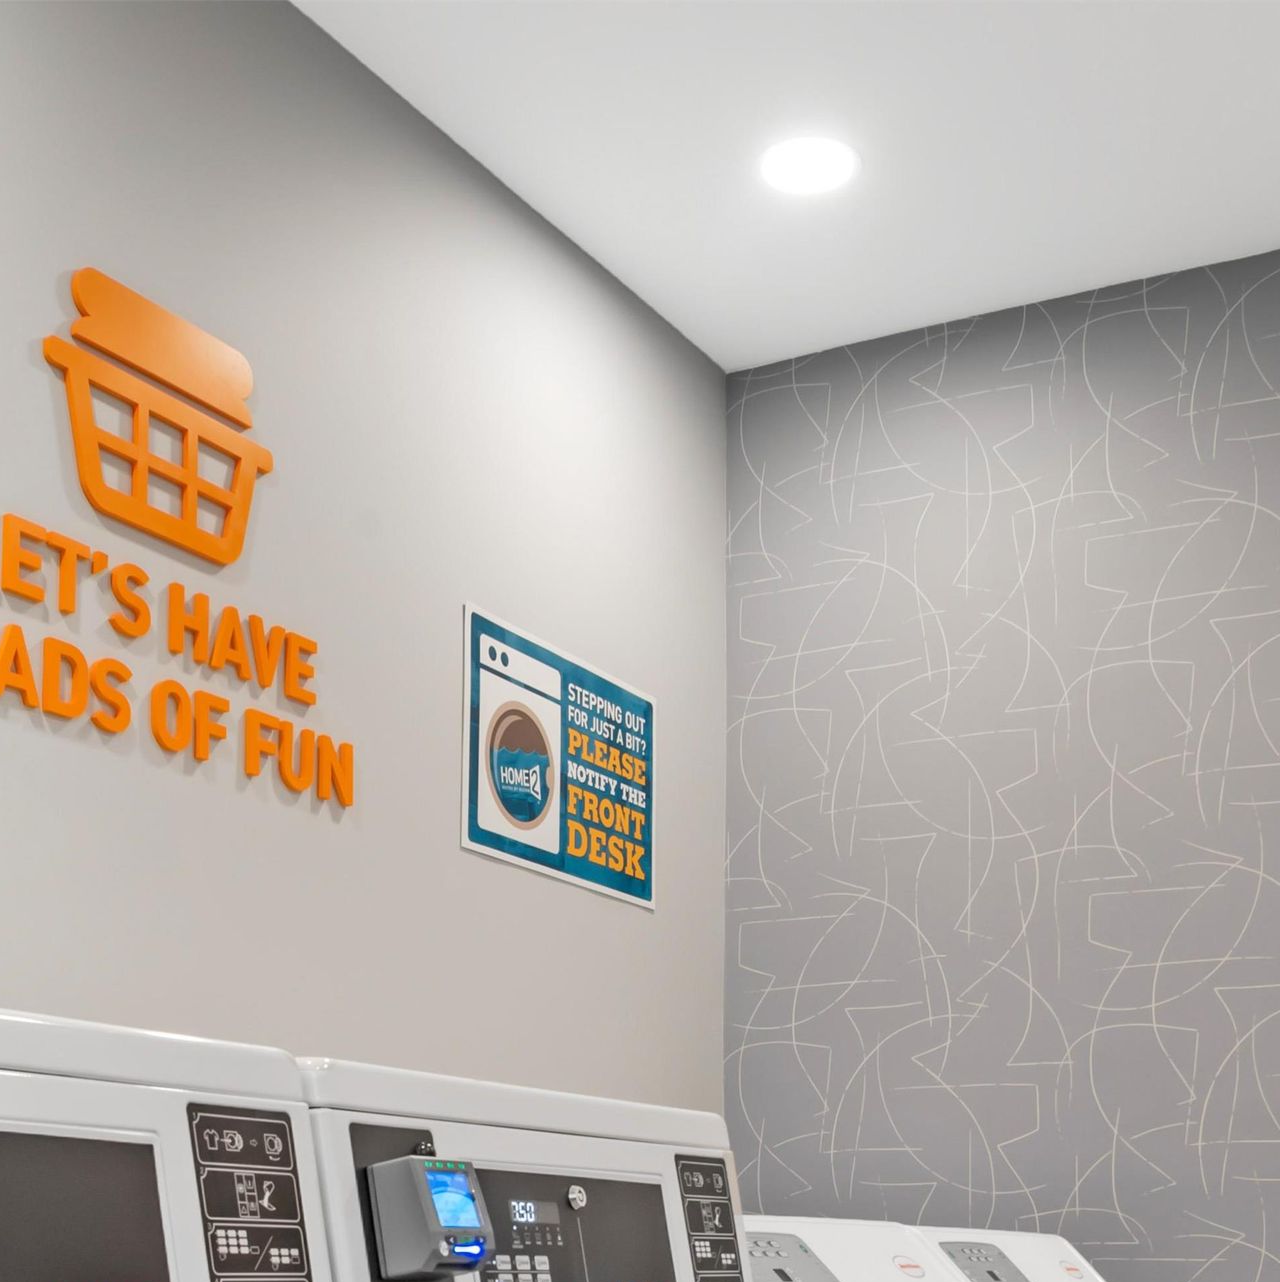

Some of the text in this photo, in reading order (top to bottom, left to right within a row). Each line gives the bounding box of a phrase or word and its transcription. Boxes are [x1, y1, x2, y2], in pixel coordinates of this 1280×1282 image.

[168, 582, 318, 707] HAVE
[568, 683, 646, 735] STEPPING OUT
[568, 704, 646, 755] FOR JUST A BIT?
[150, 680, 230, 762] OF
[244, 706, 355, 808] FUN
[568, 728, 646, 785] PLEASE
[568, 760, 646, 808] NOTIFY THE
[568, 784, 646, 840] FRONT
[567, 820, 646, 880] DESK
